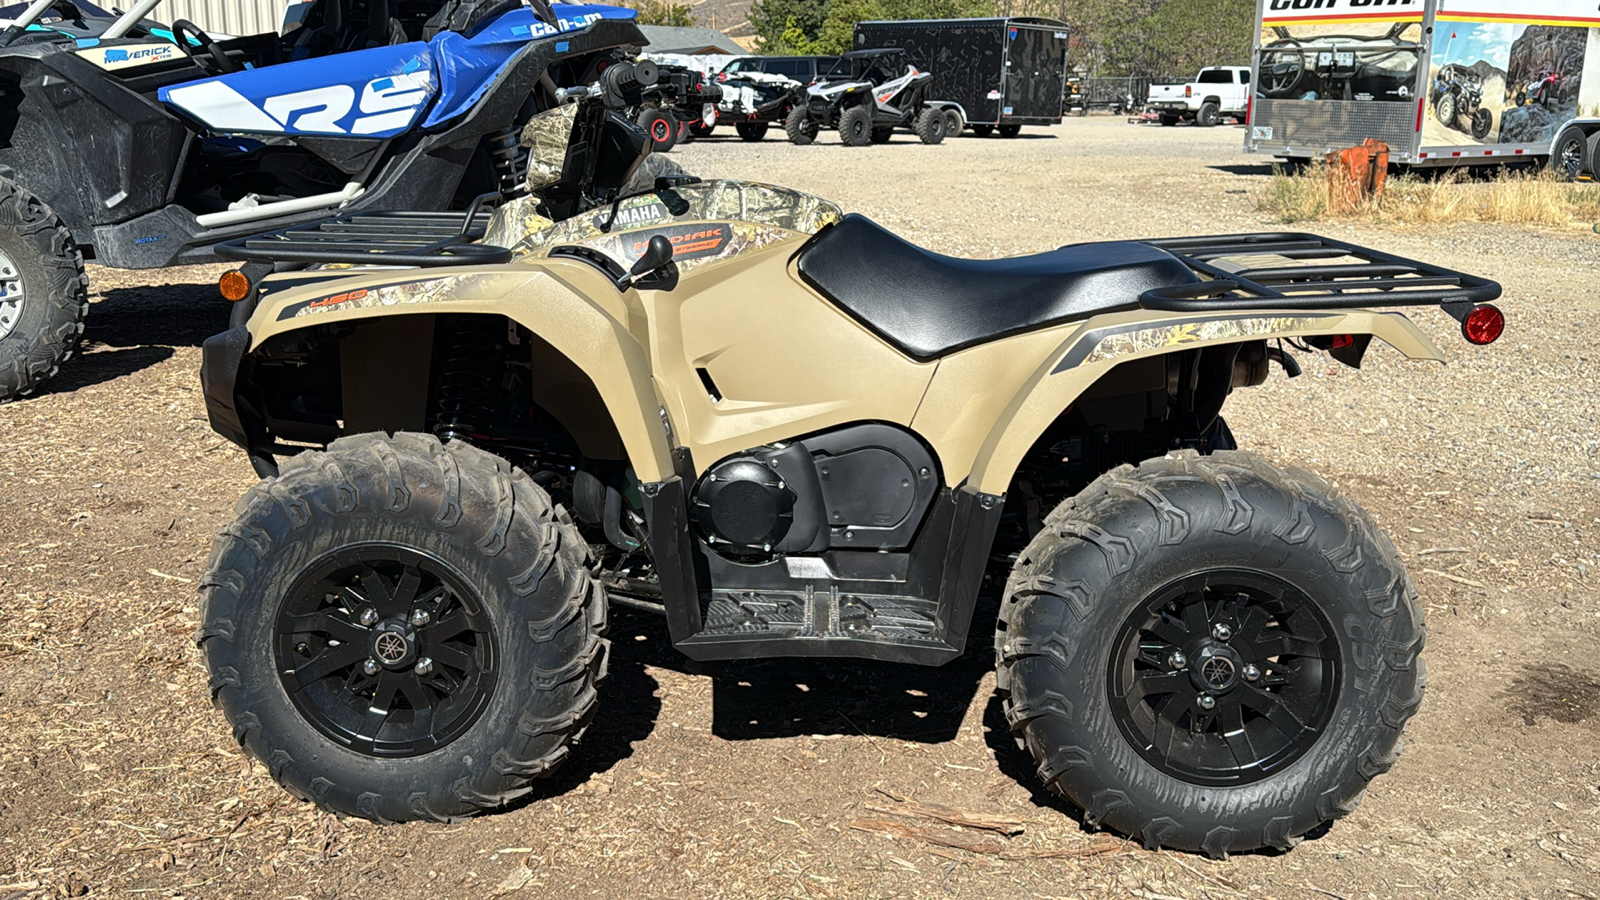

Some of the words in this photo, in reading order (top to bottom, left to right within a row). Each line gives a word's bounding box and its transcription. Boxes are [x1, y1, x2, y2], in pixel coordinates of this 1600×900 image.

[263, 70, 431, 134] RS
[599, 204, 661, 226] YMAHA
[633, 228, 723, 252] KDIAK
[309, 289, 368, 308] 450
